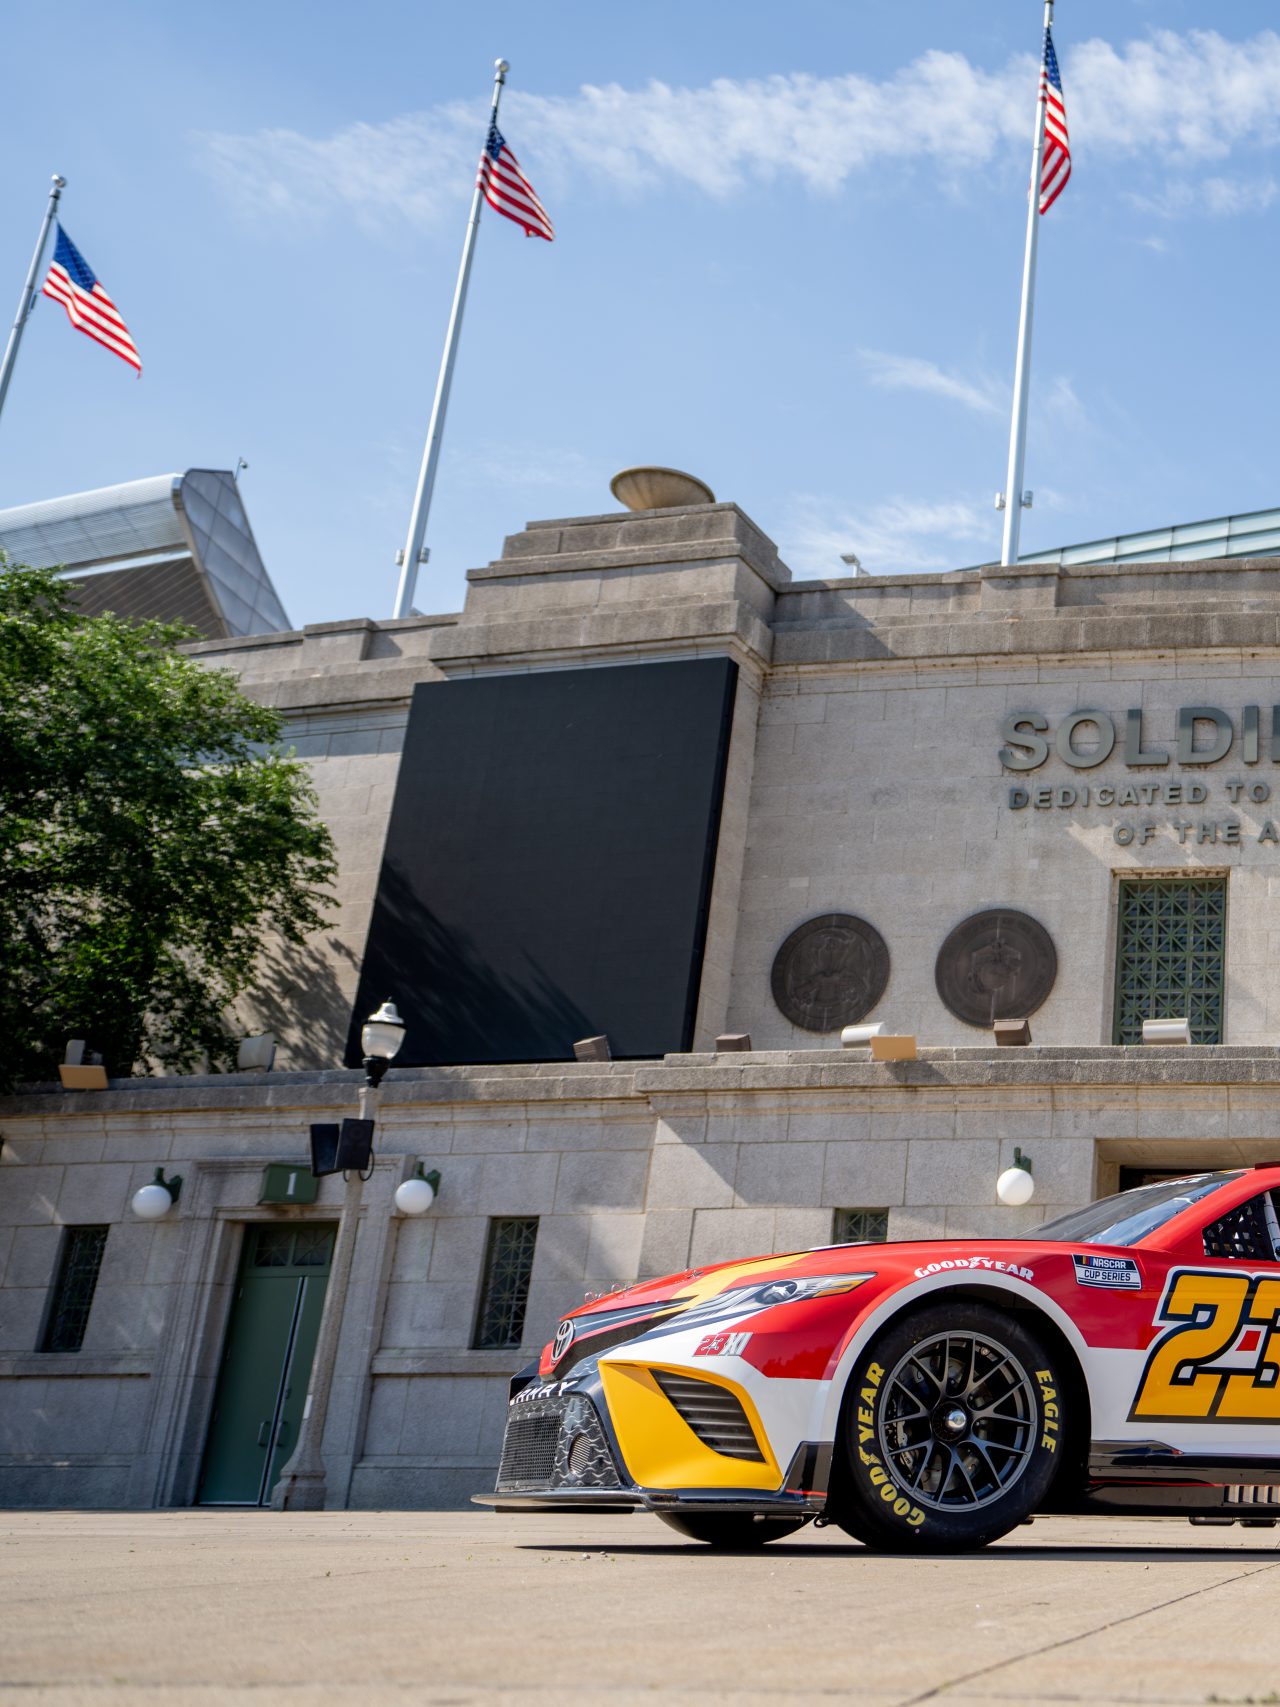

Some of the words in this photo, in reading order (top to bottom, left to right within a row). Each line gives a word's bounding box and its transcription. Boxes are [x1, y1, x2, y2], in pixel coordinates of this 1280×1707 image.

[1009, 782, 1208, 810] DEDICATED
[1227, 781, 1270, 804] TO
[1112, 819, 1156, 846] OF
[1175, 818, 1241, 845] THE
[286, 1172, 298, 1196] 1
[914, 1256, 1034, 1281] GOODYEAR
[1084, 1269, 1100, 1280] CUP
[1101, 1271, 1131, 1282] SERIES
[1093, 1258, 1126, 1269] NASCAR
[1035, 1369, 1059, 1453] EAGLE
[858, 1362, 926, 1526] GOODYEAR
